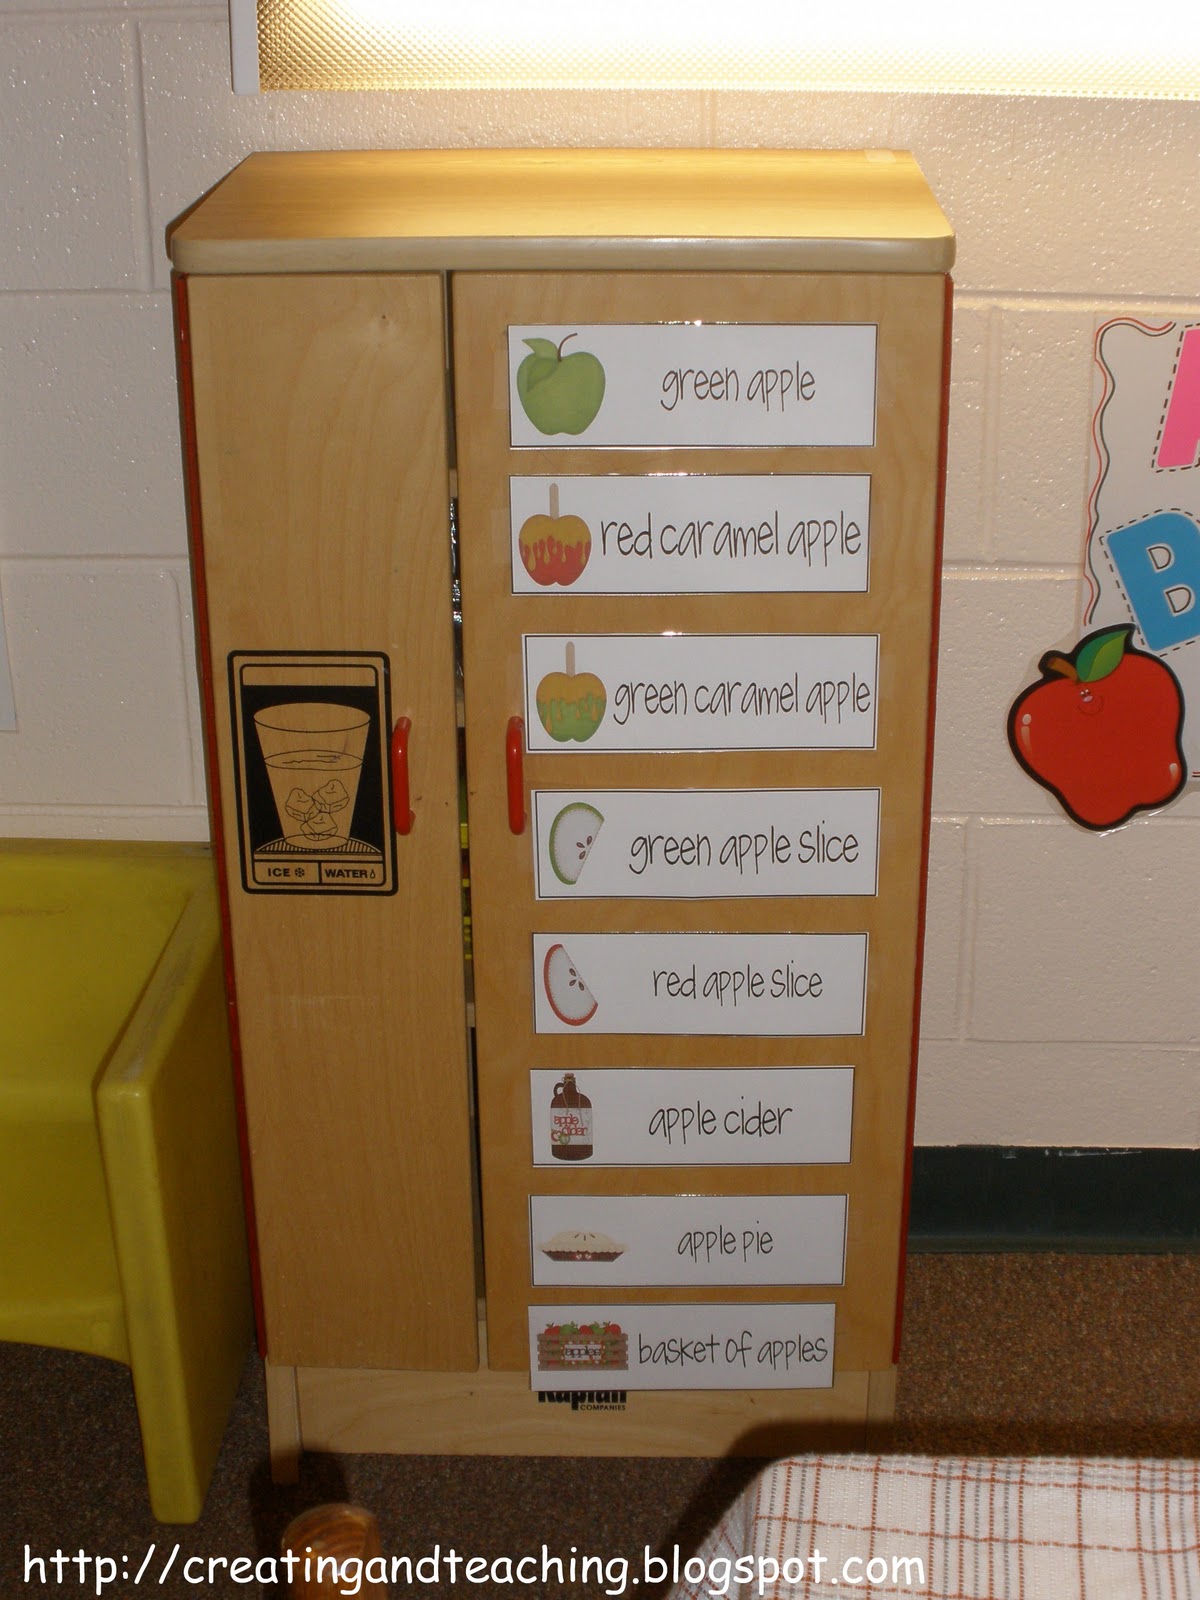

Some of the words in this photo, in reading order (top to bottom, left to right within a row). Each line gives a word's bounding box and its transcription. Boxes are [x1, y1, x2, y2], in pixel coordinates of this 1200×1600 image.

[659, 367, 740, 412] green
[746, 360, 816, 412] apple
[600, 511, 654, 560] red
[659, 510, 779, 559] caramel
[786, 510, 862, 568] apple
[612, 680, 688, 726] green
[694, 671, 799, 717] caramel
[805, 671, 871, 725] apple
[267, 867, 291, 877] ICE
[628, 833, 712, 875] green
[719, 824, 792, 876] apple
[797, 819, 860, 864] slice
[324, 868, 368, 879] WATER
[652, 963, 697, 1000] red
[702, 963, 766, 1008] apple
[769, 959, 823, 999] slice
[648, 1100, 717, 1145] apple
[723, 1095, 794, 1138] cider
[677, 1224, 737, 1264] apple
[742, 1220, 774, 1264] pie
[638, 1332, 721, 1367] basket
[724, 1330, 753, 1369] of
[757, 1333, 829, 1371] apples
